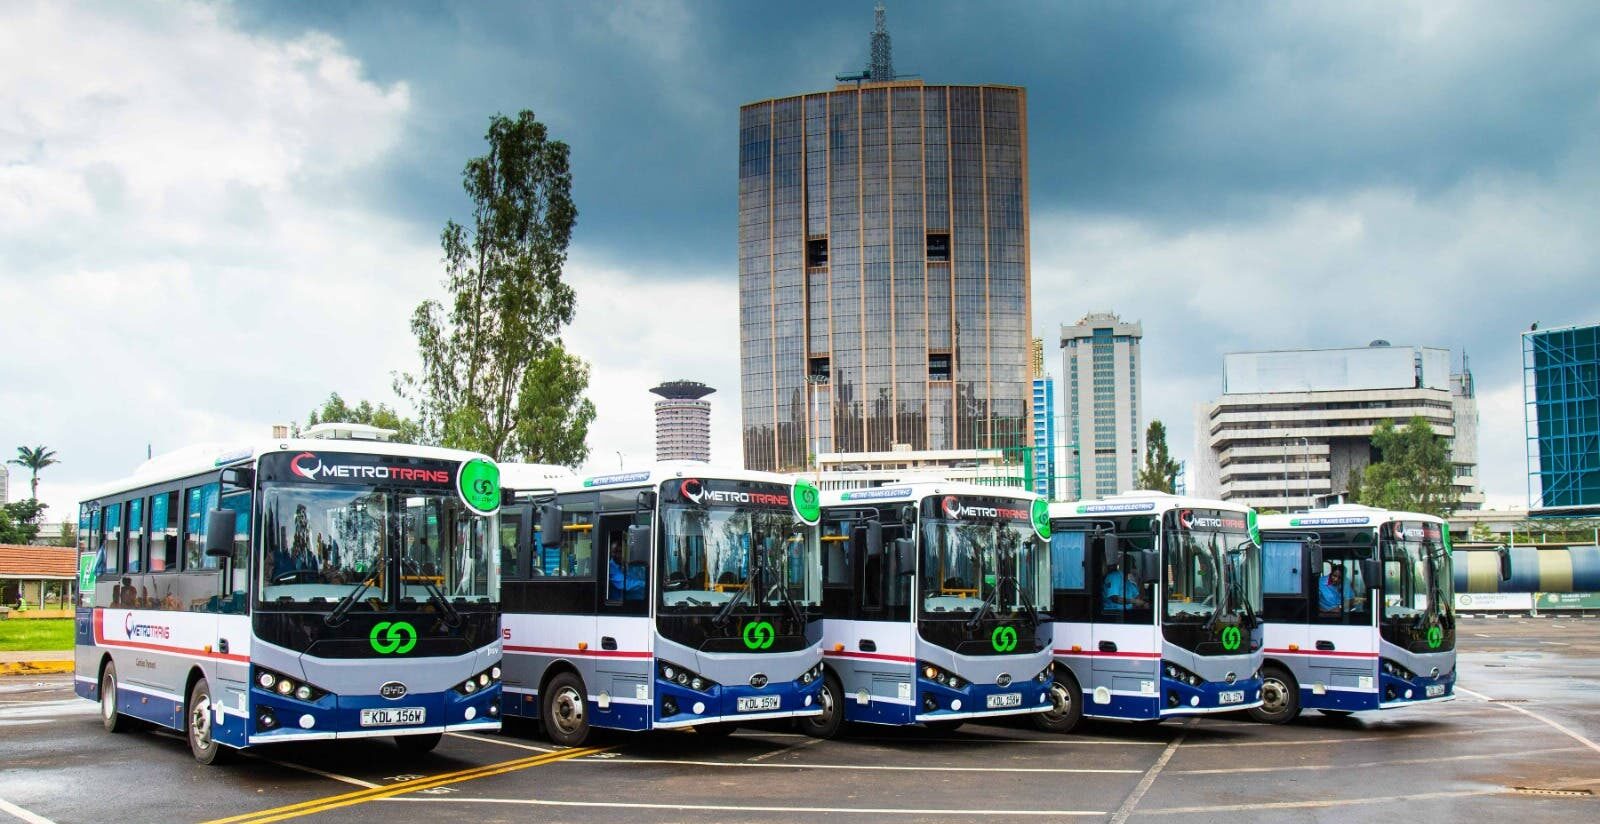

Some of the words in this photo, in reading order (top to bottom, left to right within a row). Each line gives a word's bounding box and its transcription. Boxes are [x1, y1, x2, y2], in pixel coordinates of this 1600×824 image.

[322, 464, 449, 483] METROTRANS
[704, 490, 789, 506] METROTRANS
[961, 506, 1029, 519] METROTRANS
[383, 685, 405, 695] BYD
[744, 698, 759, 709] KDL
[372, 709, 392, 723] KDL
[395, 708, 421, 722] 156W
